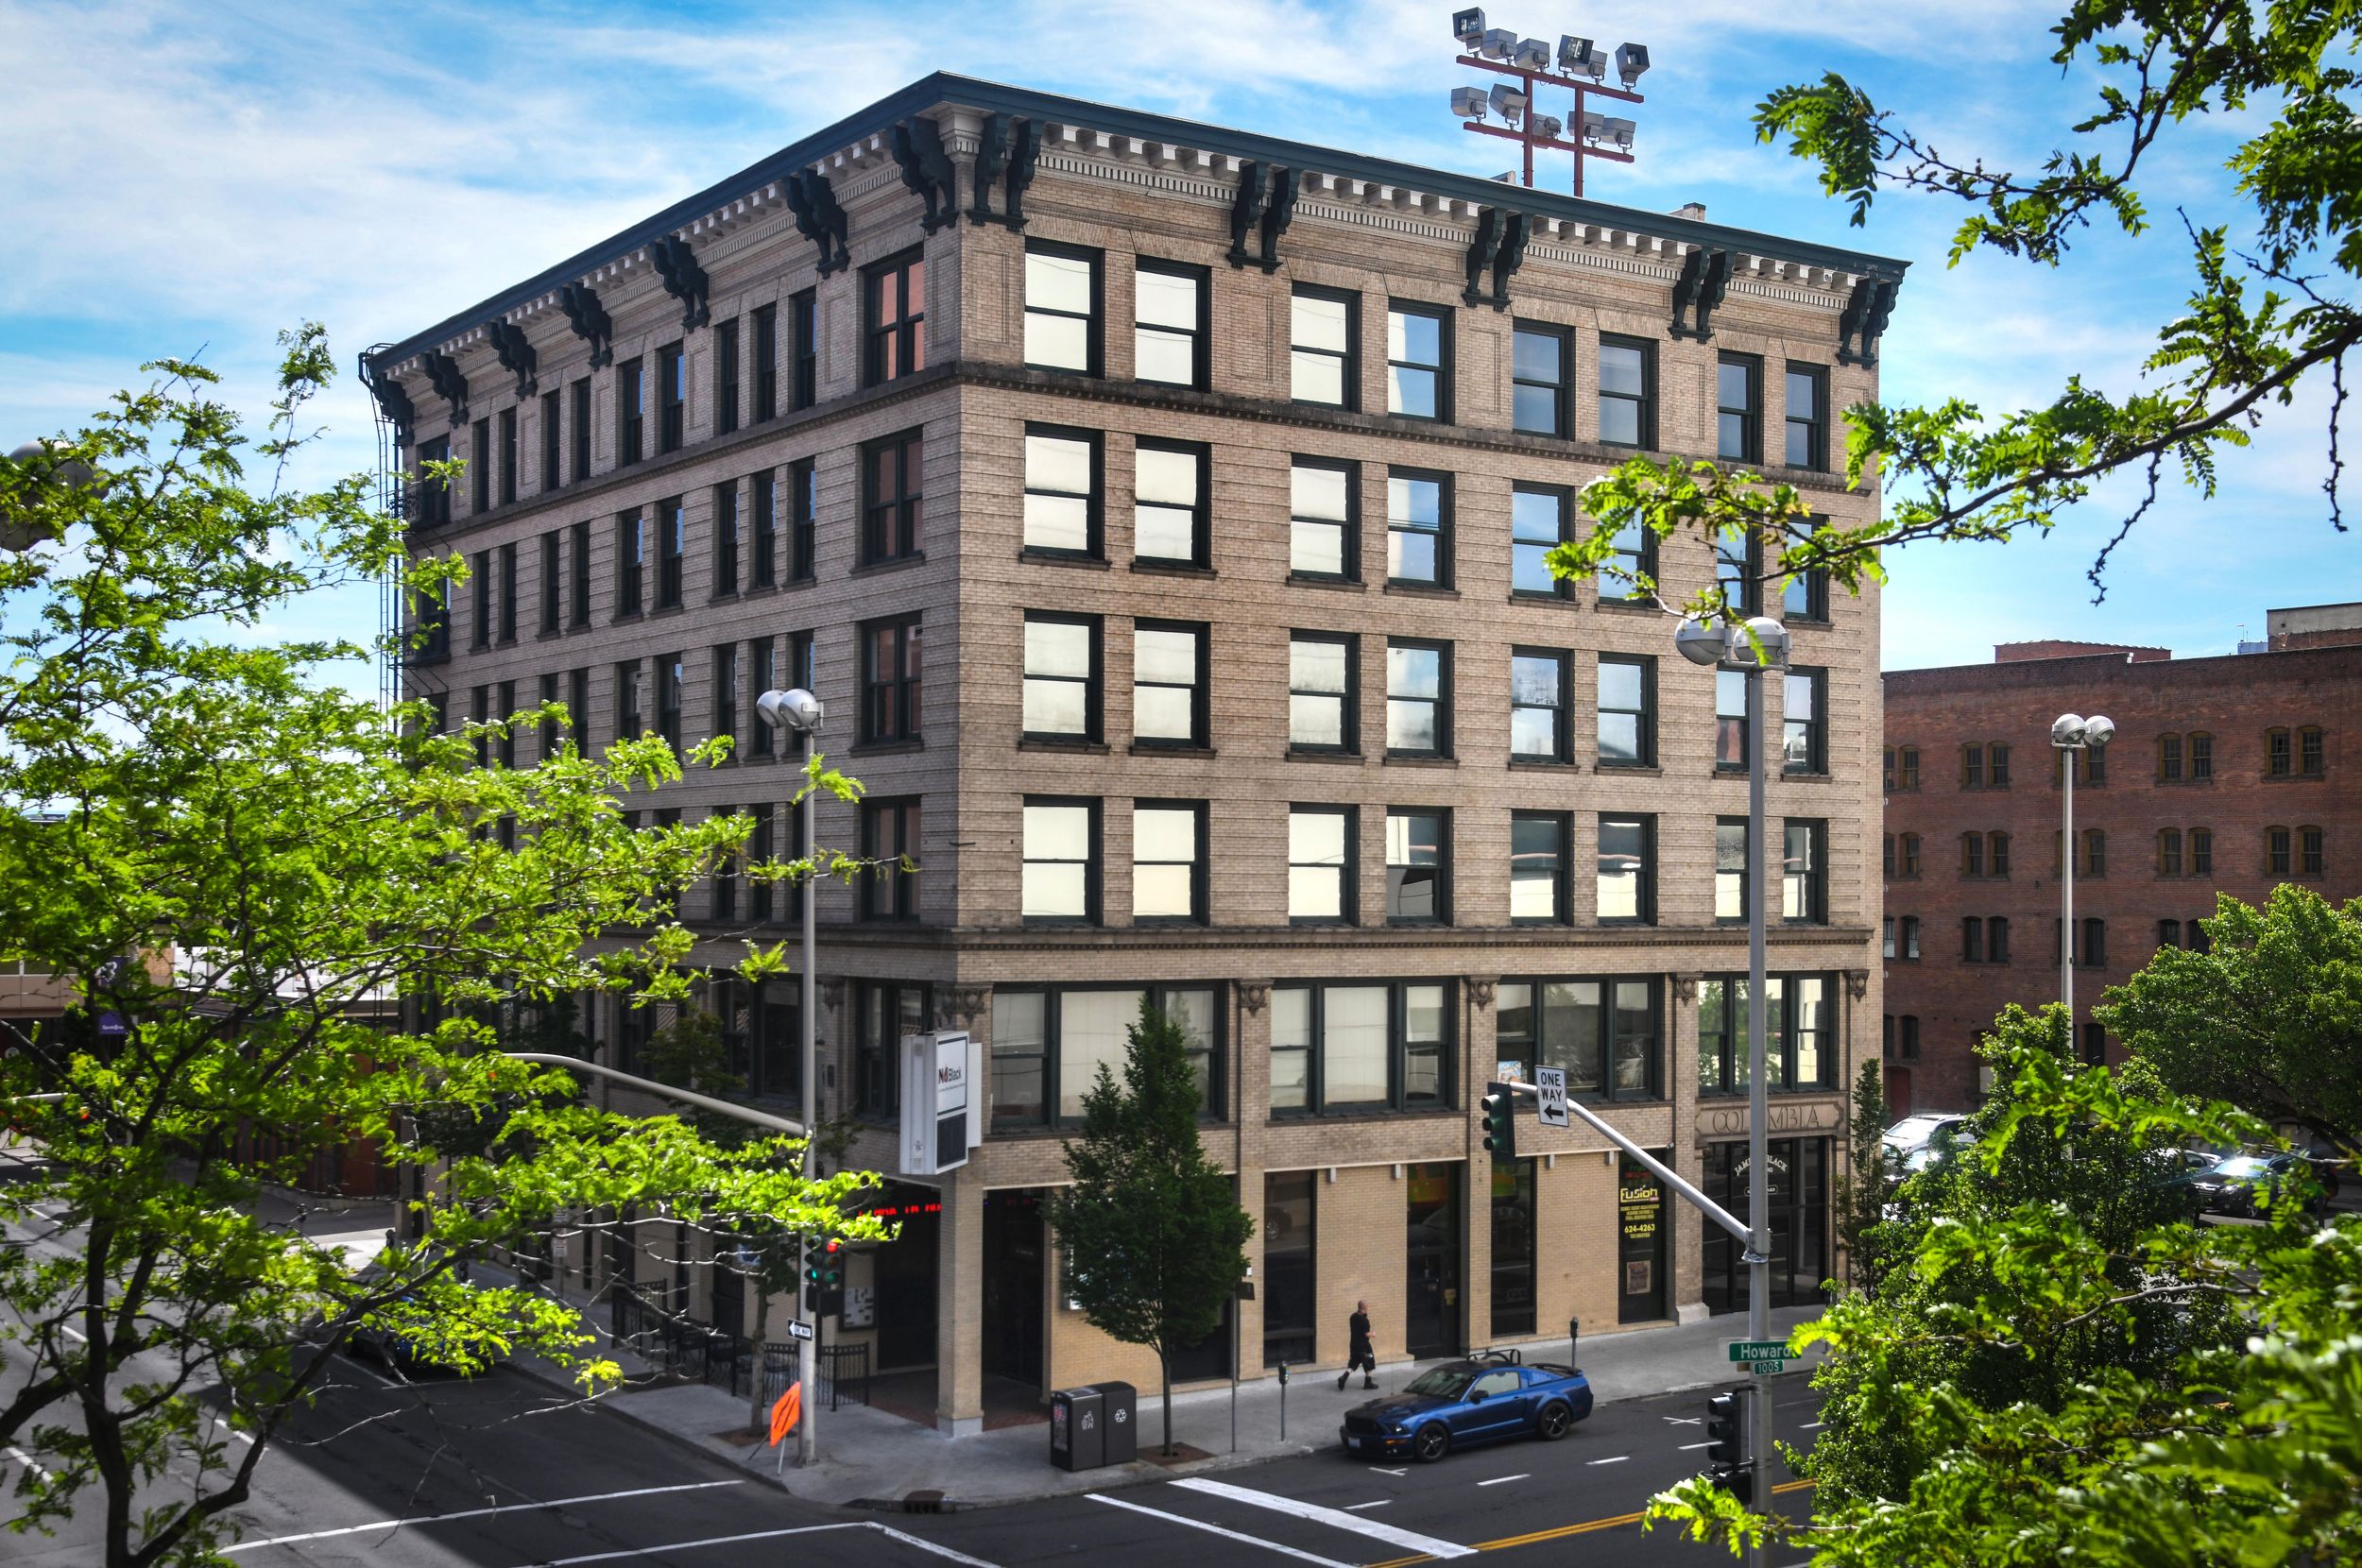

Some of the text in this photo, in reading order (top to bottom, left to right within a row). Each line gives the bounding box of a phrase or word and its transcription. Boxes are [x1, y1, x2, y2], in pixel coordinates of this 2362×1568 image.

[1540, 1072, 1561, 1086] ONE
[1541, 1087, 1562, 1102] WAY
[1713, 1106, 1820, 1133] COLMBIA
[1620, 1185, 1658, 1202] Fusion
[1624, 1223, 1655, 1234] 624-4263
[1740, 1344, 1790, 1359] Howard
